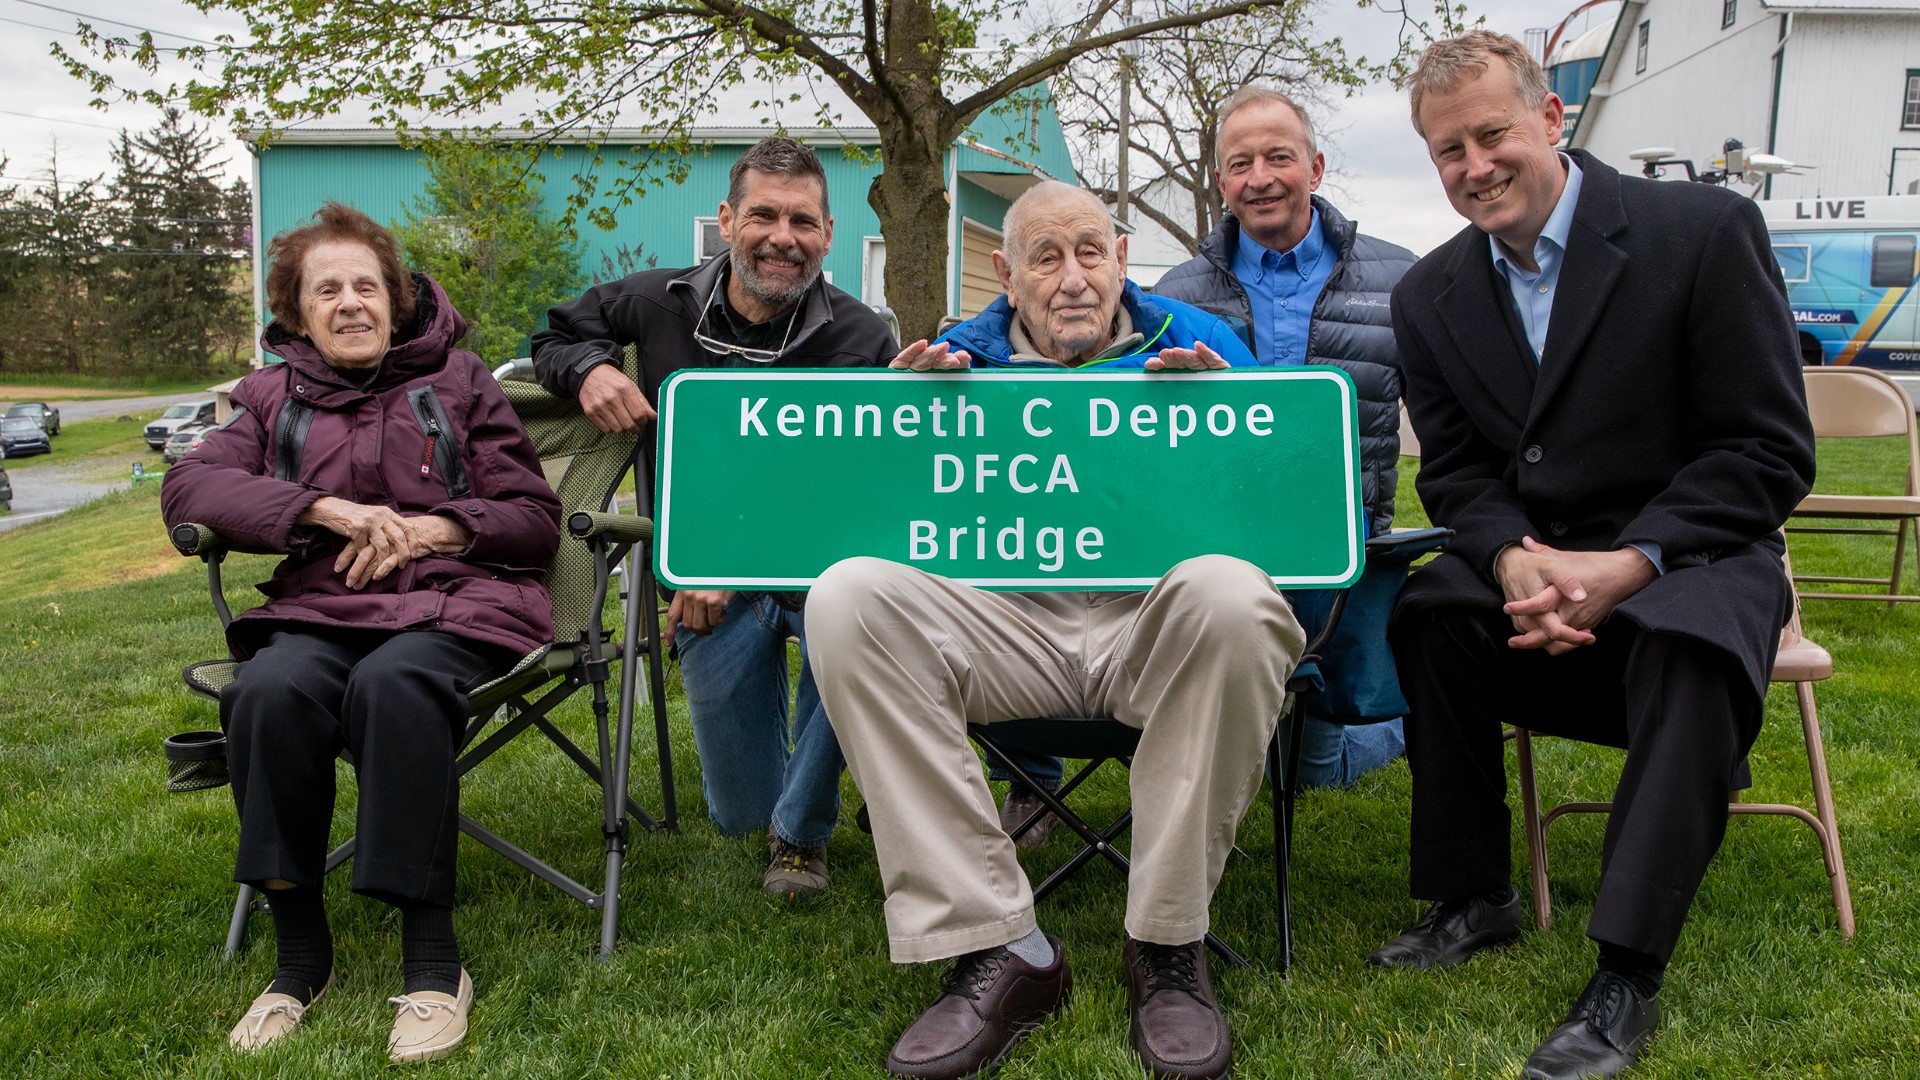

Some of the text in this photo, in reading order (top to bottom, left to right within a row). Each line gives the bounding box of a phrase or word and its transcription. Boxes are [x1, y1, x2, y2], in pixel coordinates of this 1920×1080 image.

[1796, 201, 1866, 219] LIVE
[1345, 298, 1367, 306] Eddie
[1888, 352, 1920, 361] COVE
[740, 396, 1274, 448] Kenneth C Depoe
[933, 454, 1079, 494] DFCA
[909, 517, 1104, 572] Bridge
